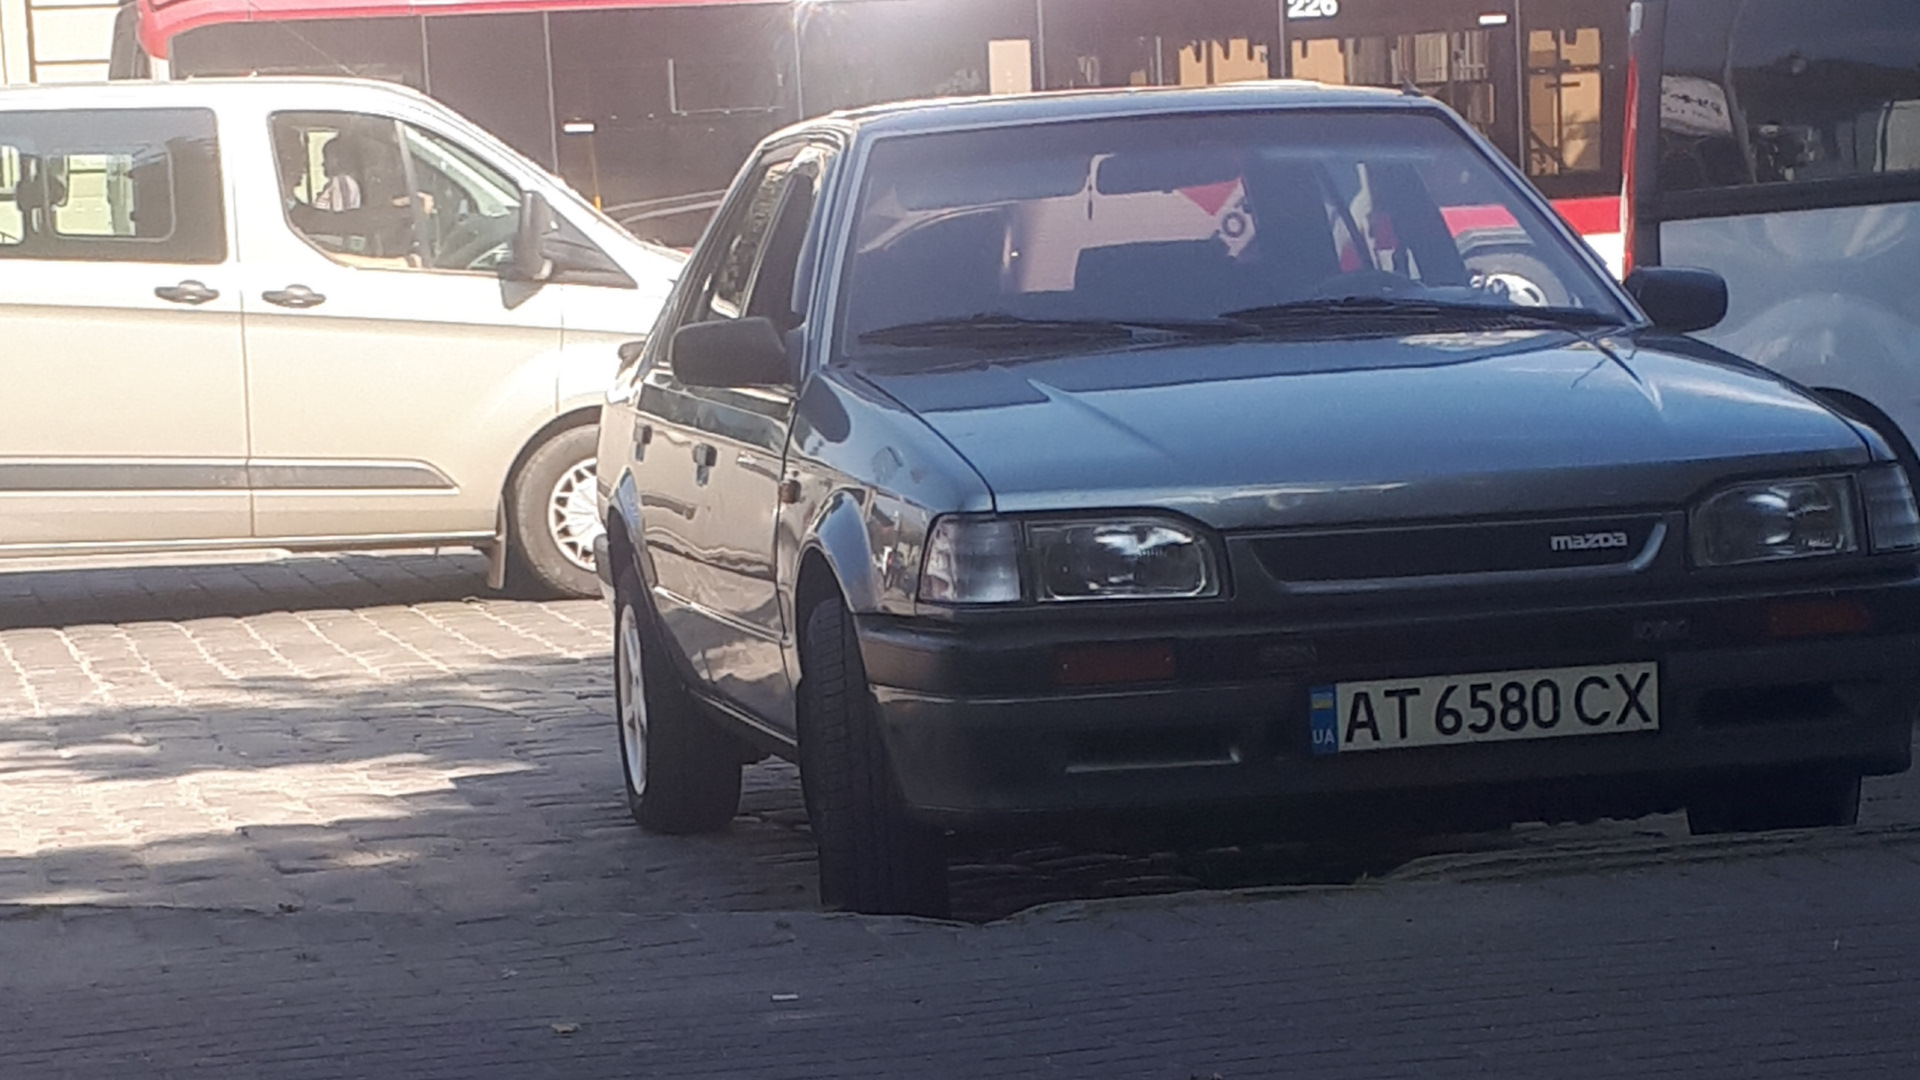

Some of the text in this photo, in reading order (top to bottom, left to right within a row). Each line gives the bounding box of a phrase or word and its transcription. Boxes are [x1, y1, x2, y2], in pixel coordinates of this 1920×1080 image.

[1287, 0, 1338, 18] 226
[1550, 532, 1628, 551] mazda
[1345, 672, 1652, 743] AT 6580 CX
[1312, 728, 1336, 745] UA
